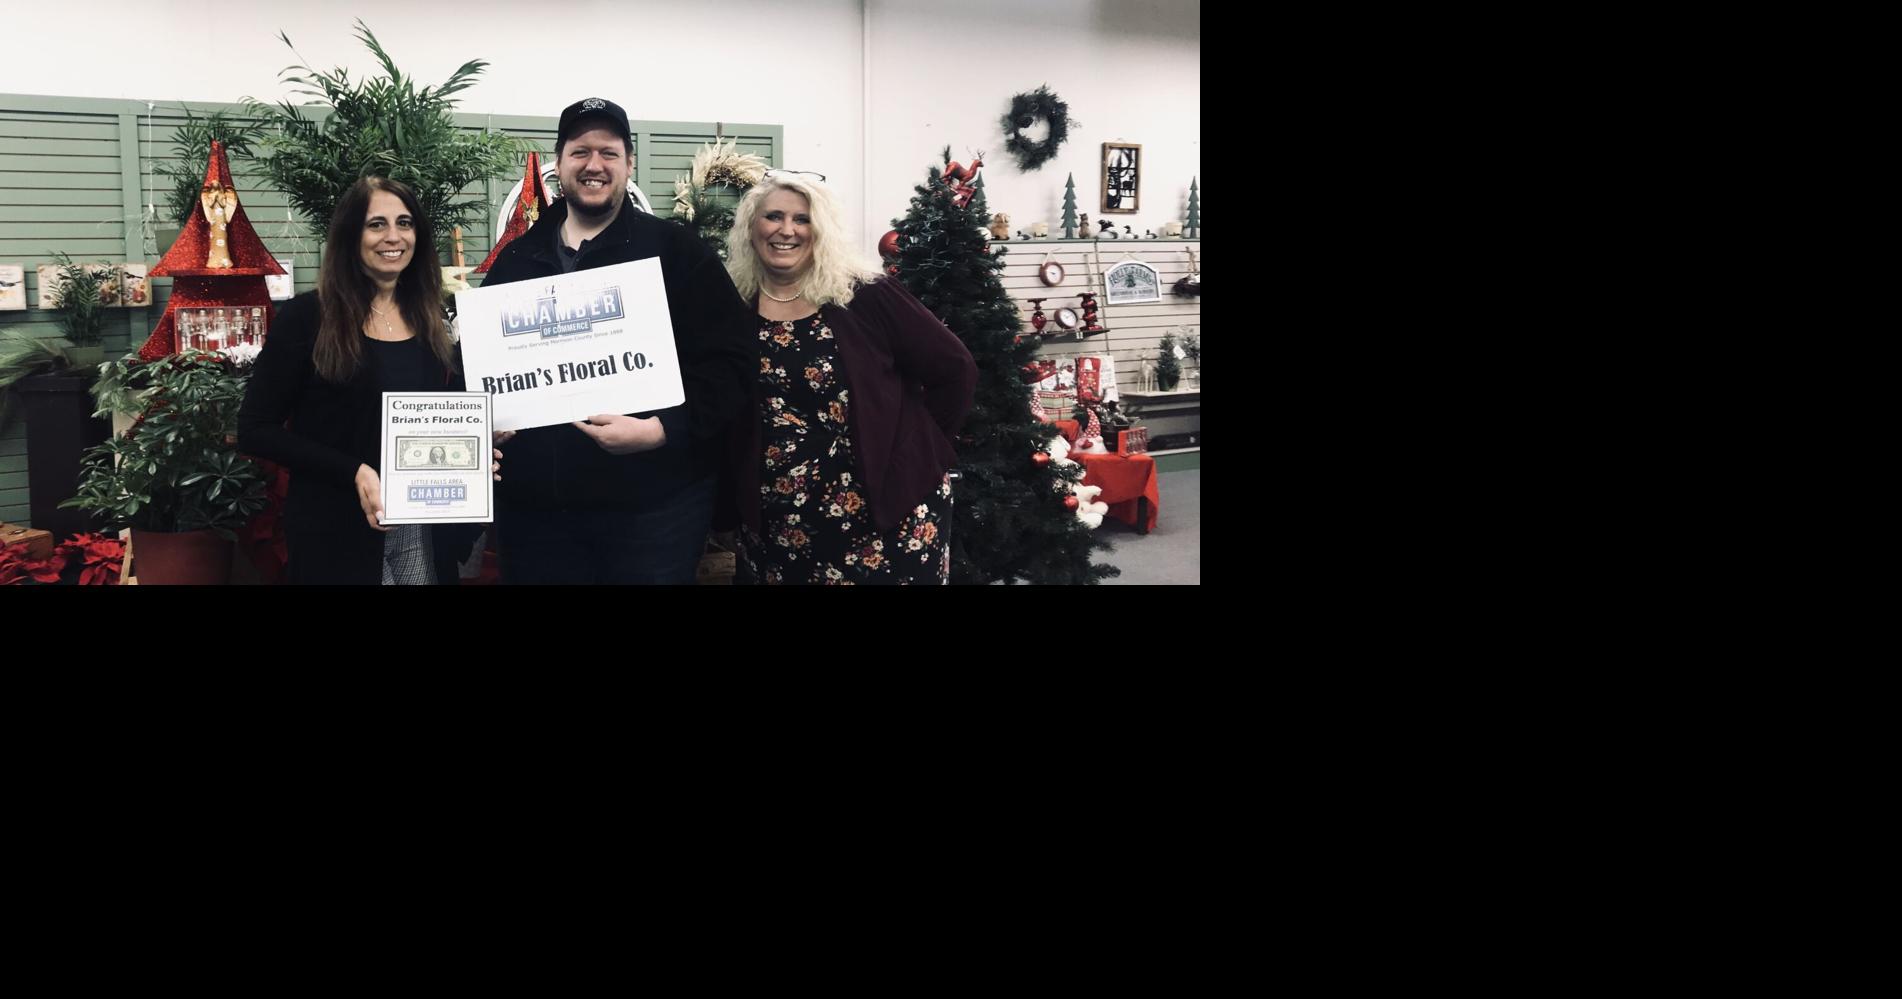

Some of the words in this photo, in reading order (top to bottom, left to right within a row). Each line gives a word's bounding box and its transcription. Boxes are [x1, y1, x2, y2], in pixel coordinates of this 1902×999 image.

[508, 294, 617, 329] CHAMBER
[543, 327, 552, 336] OF
[553, 323, 589, 335] COMMERCE
[482, 368, 554, 396] Brian's
[557, 354, 618, 384] Floral
[622, 350, 654, 372] Co.
[392, 400, 483, 412] Congratulations
[392, 415, 430, 424] Brian's
[432, 415, 463, 424] Floral
[466, 415, 483, 424] Co.
[410, 487, 464, 499] CHAMBER
